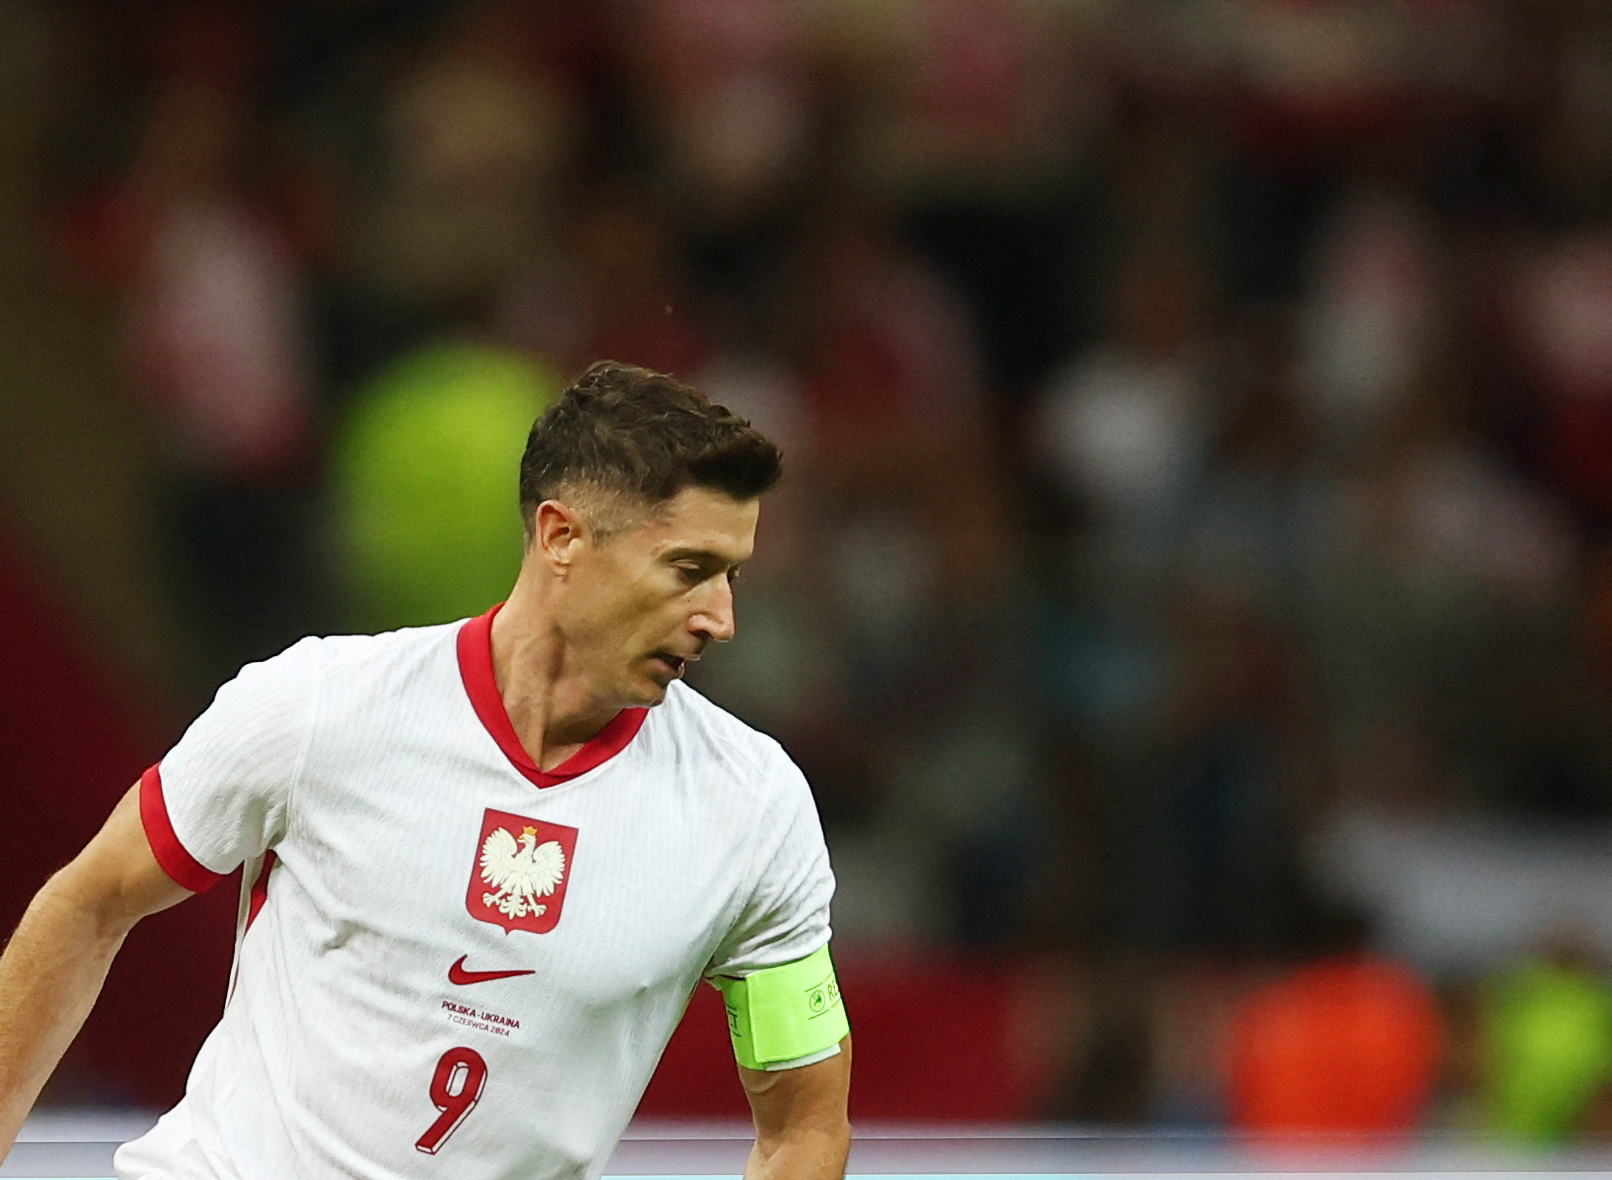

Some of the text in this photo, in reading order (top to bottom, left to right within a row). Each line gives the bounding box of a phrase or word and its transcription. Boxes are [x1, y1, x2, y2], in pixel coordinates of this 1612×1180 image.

[441, 1000, 476, 1017] POLSKA
[480, 1011, 520, 1028] UKRAINA
[452, 1015, 489, 1031] CZERWCA
[490, 1025, 510, 1037] 2024
[415, 1046, 488, 1155] 9
